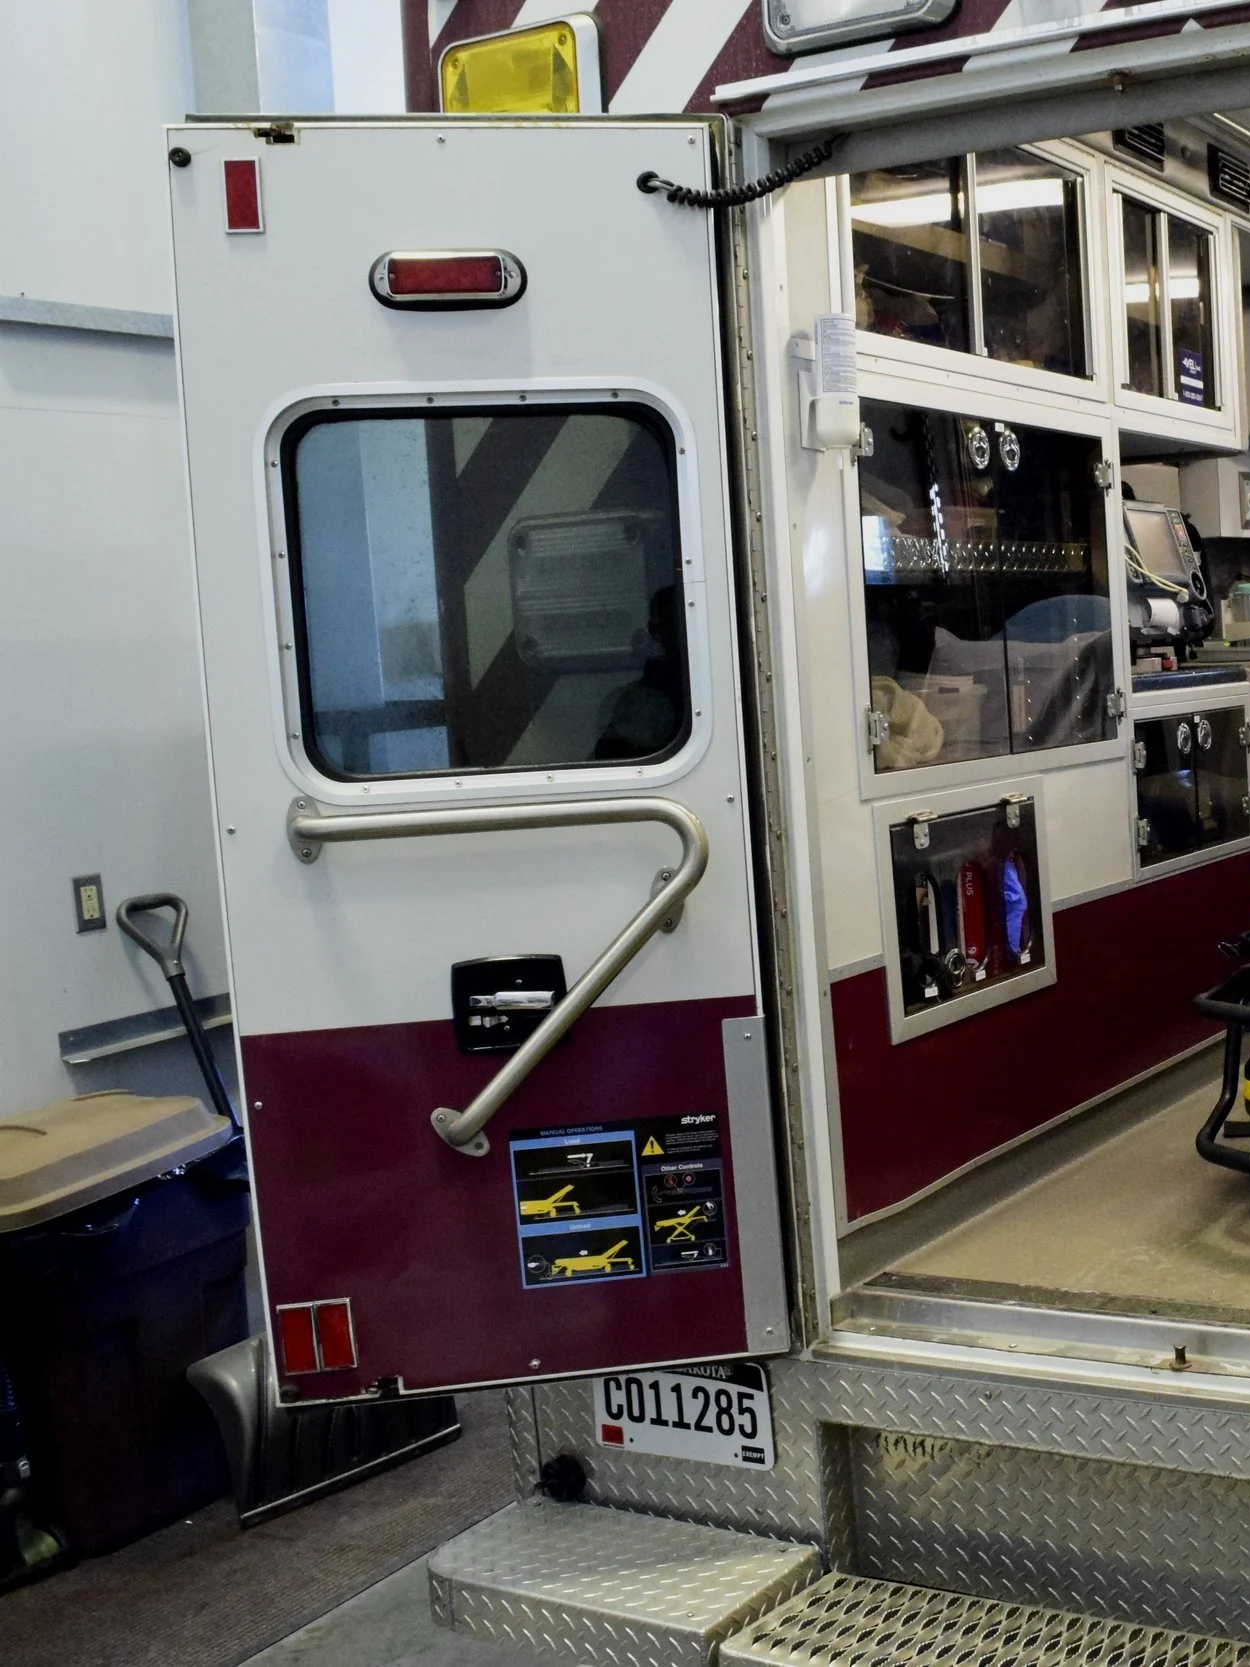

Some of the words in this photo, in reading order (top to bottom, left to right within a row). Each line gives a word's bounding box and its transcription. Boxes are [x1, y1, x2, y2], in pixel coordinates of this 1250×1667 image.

[965, 871, 974, 896] PLUS
[680, 1113, 717, 1125] stryker
[539, 1128, 566, 1136] MANUAL
[566, 1125, 604, 1134] OPERATIONS
[660, 1164, 677, 1172] Other
[677, 1162, 704, 1170] Controls
[676, 1365, 727, 1379] AKOTA
[742, 1450, 764, 1460] EXEMPT
